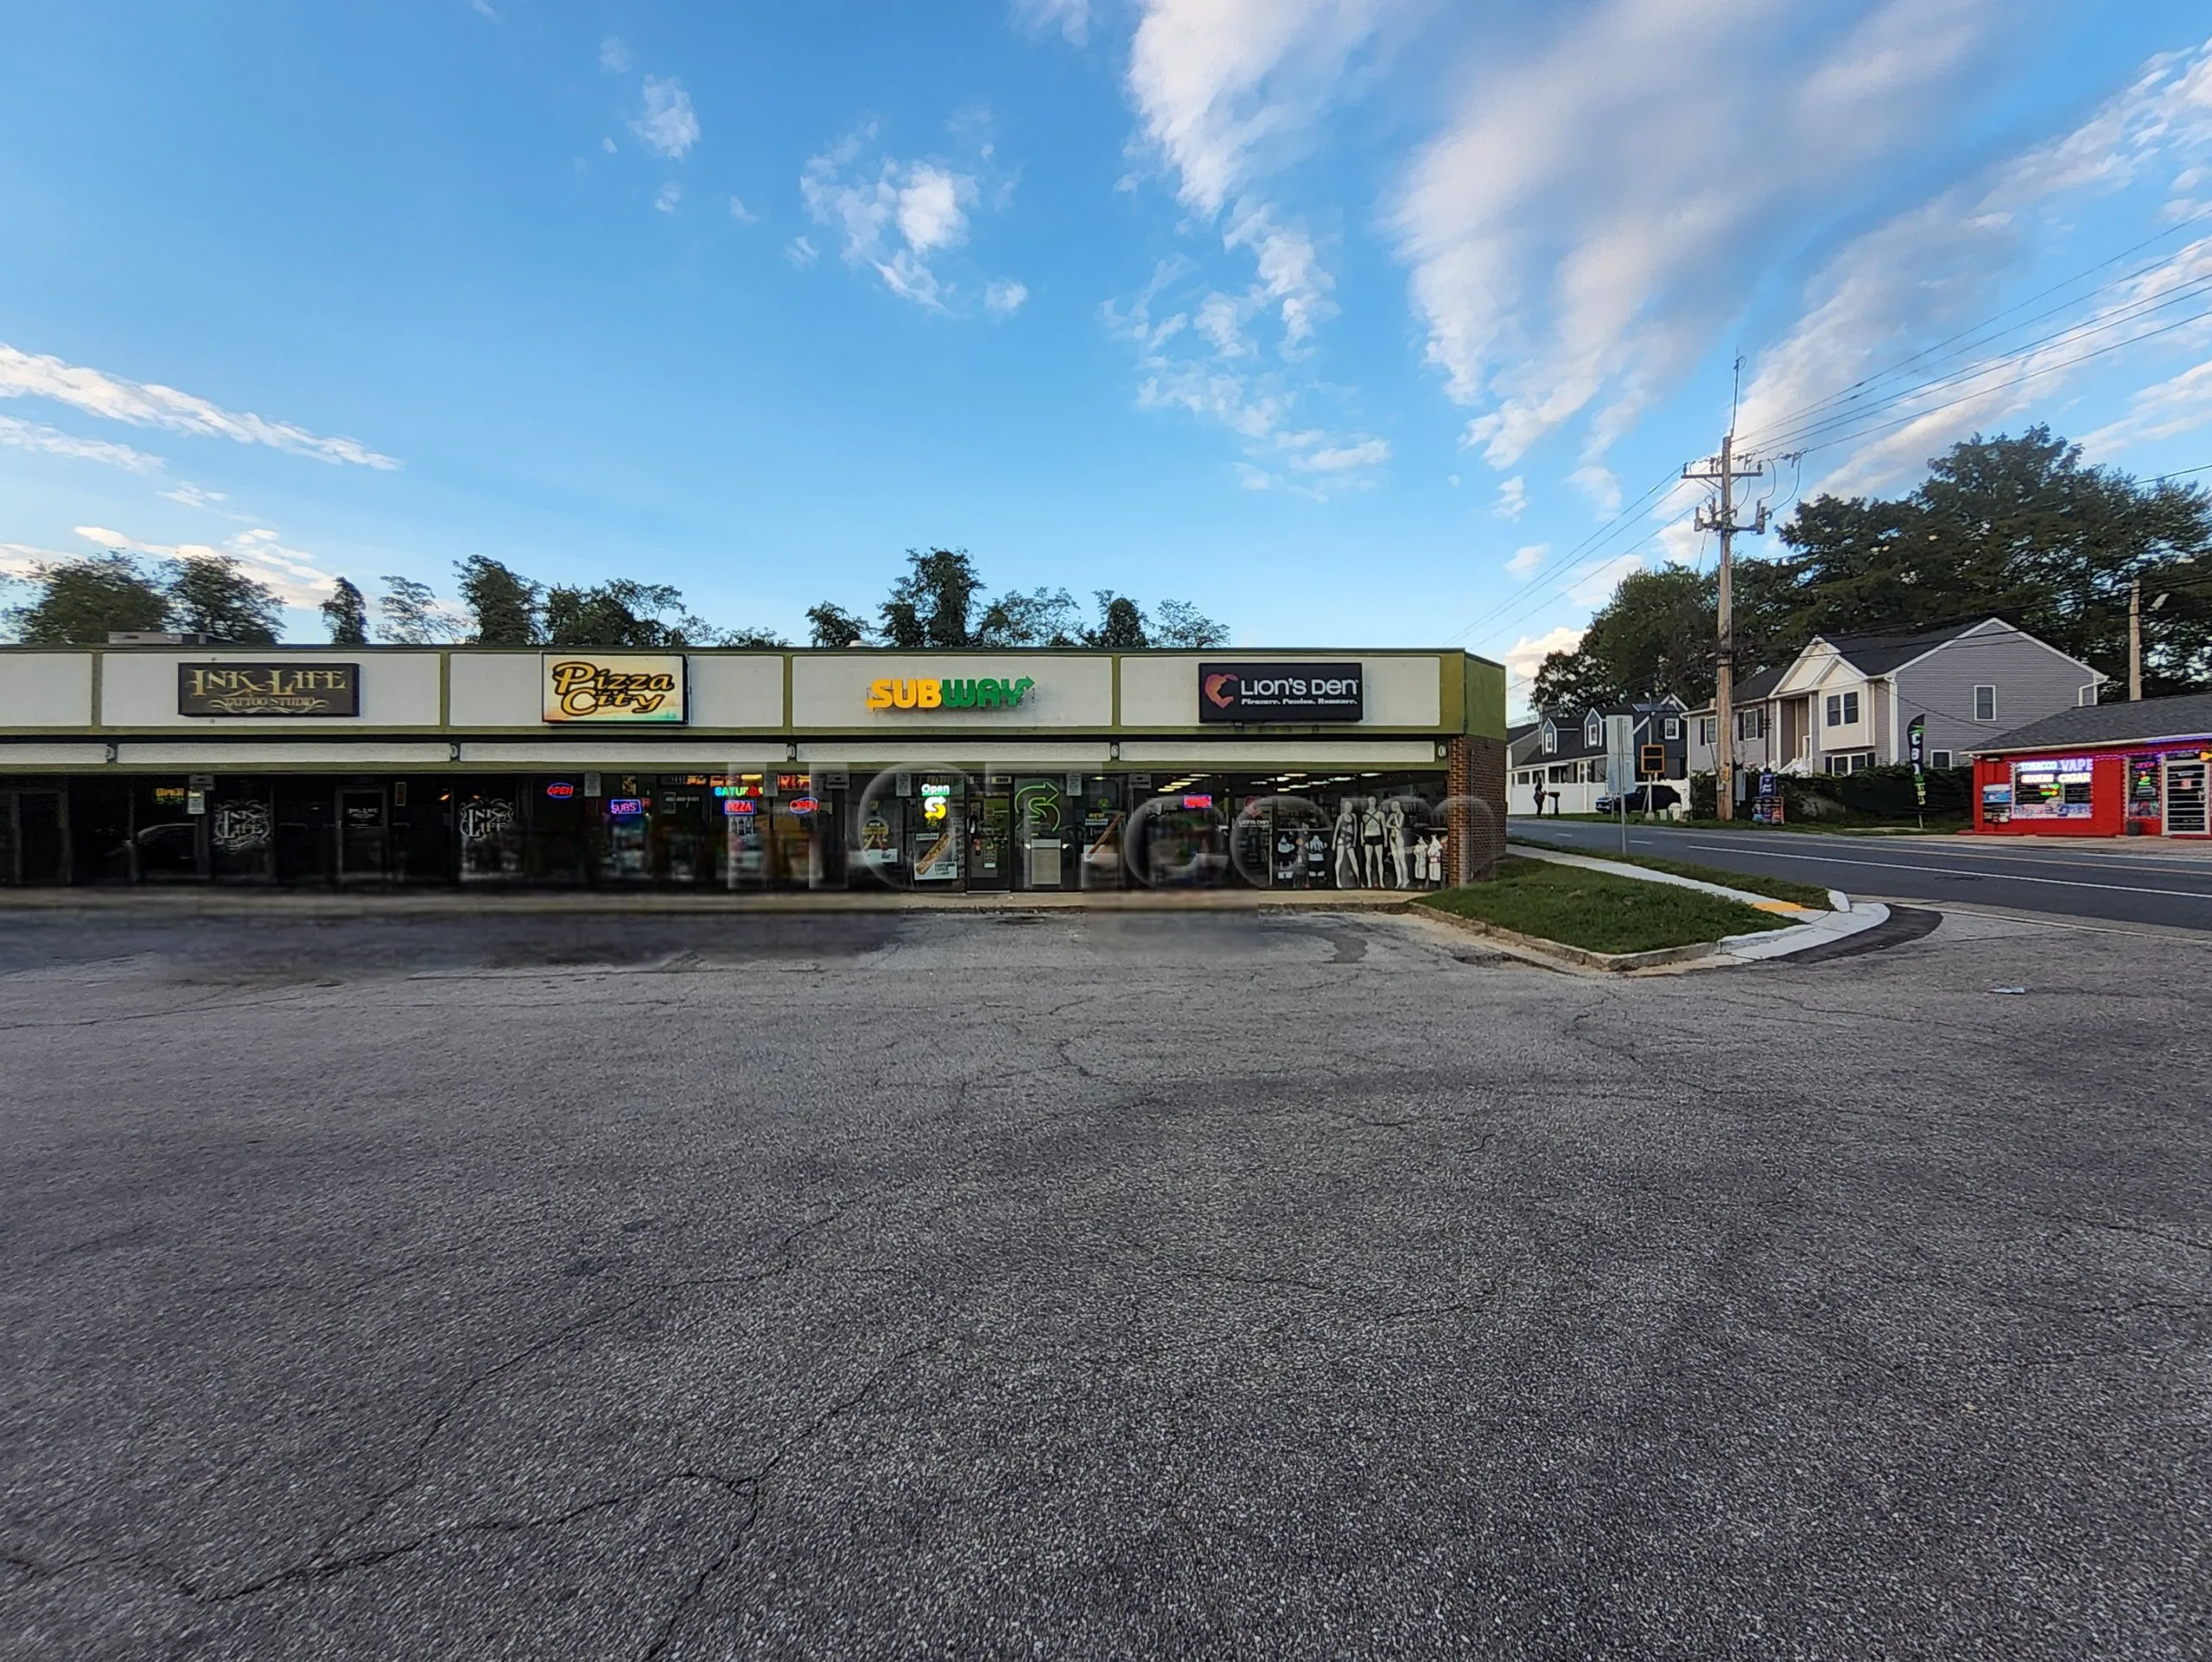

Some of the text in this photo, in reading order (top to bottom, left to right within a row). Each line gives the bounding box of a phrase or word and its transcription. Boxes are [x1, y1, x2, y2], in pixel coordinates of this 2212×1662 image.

[186, 669, 346, 697] INK LIFE
[553, 661, 674, 695] Pizza
[865, 675, 1035, 710] SUBWAY
[224, 697, 315, 706] TATTOO STUDIO
[561, 687, 666, 716] City
[2058, 759, 2094, 771] VAPE
[547, 786, 574, 796] OPEN
[921, 783, 950, 796] Open
[611, 802, 637, 813] SUBS
[727, 802, 752, 812] PIZZA
[790, 800, 817, 812] OPEN
